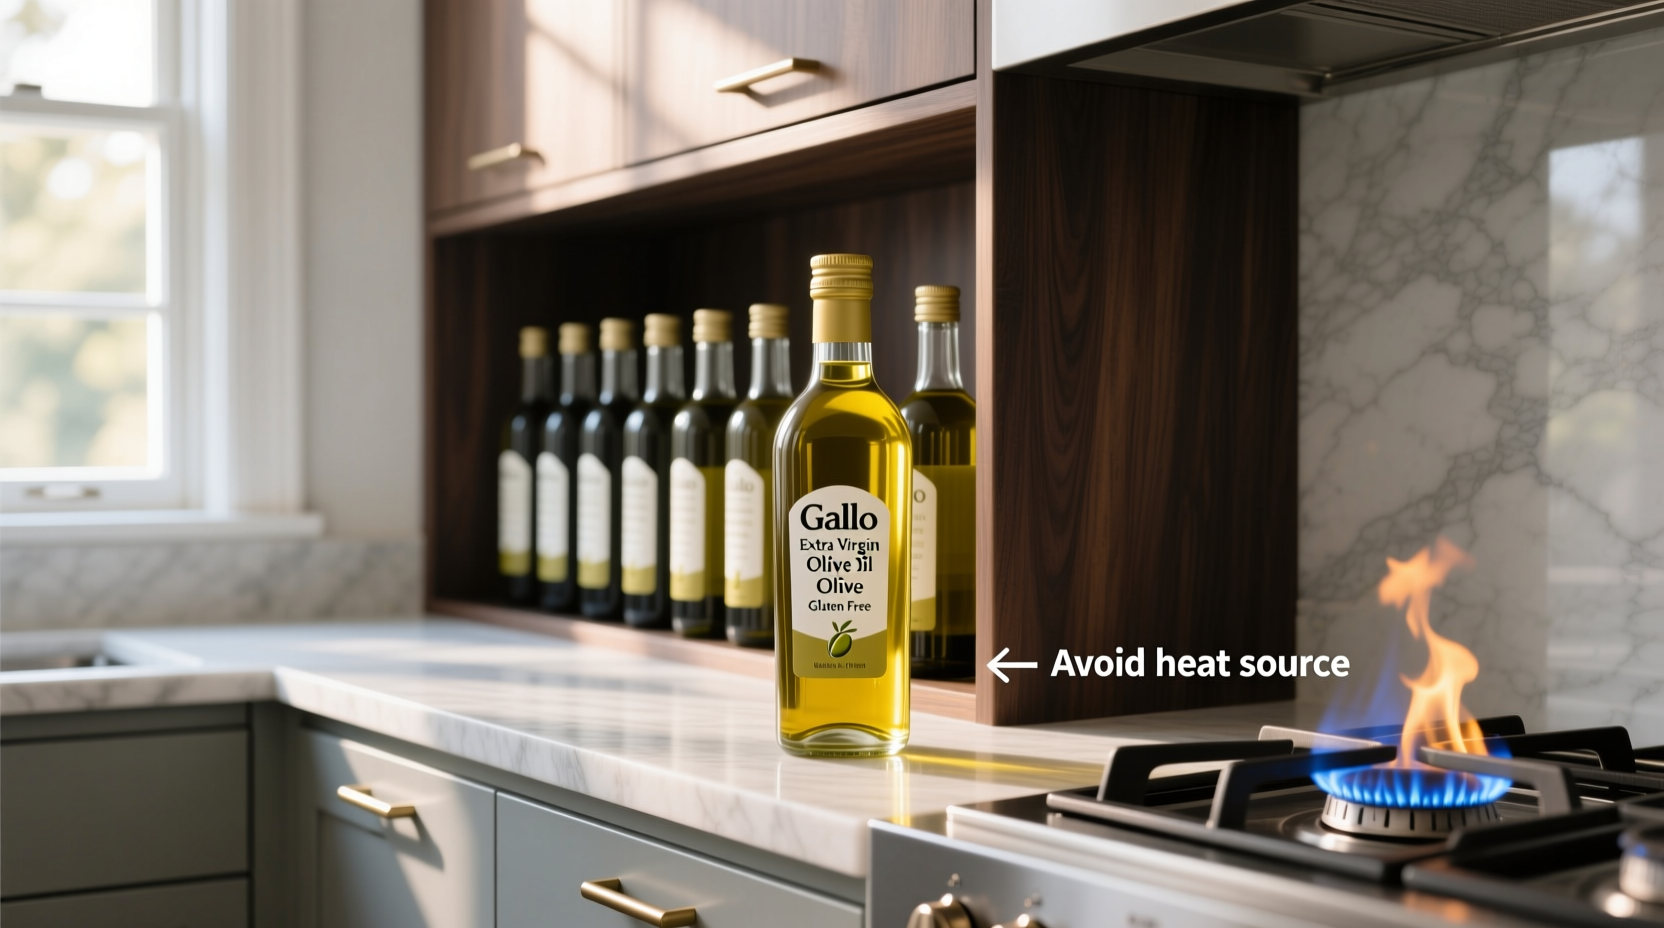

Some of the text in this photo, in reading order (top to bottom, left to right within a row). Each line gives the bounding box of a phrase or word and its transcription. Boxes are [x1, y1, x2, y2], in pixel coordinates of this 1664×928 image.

[800, 502, 878, 531] Gallo
[799, 537, 880, 555] Extra Virgin
[806, 554, 852, 573] Olive
[816, 576, 864, 594] Olive
[847, 600, 872, 612] Free
